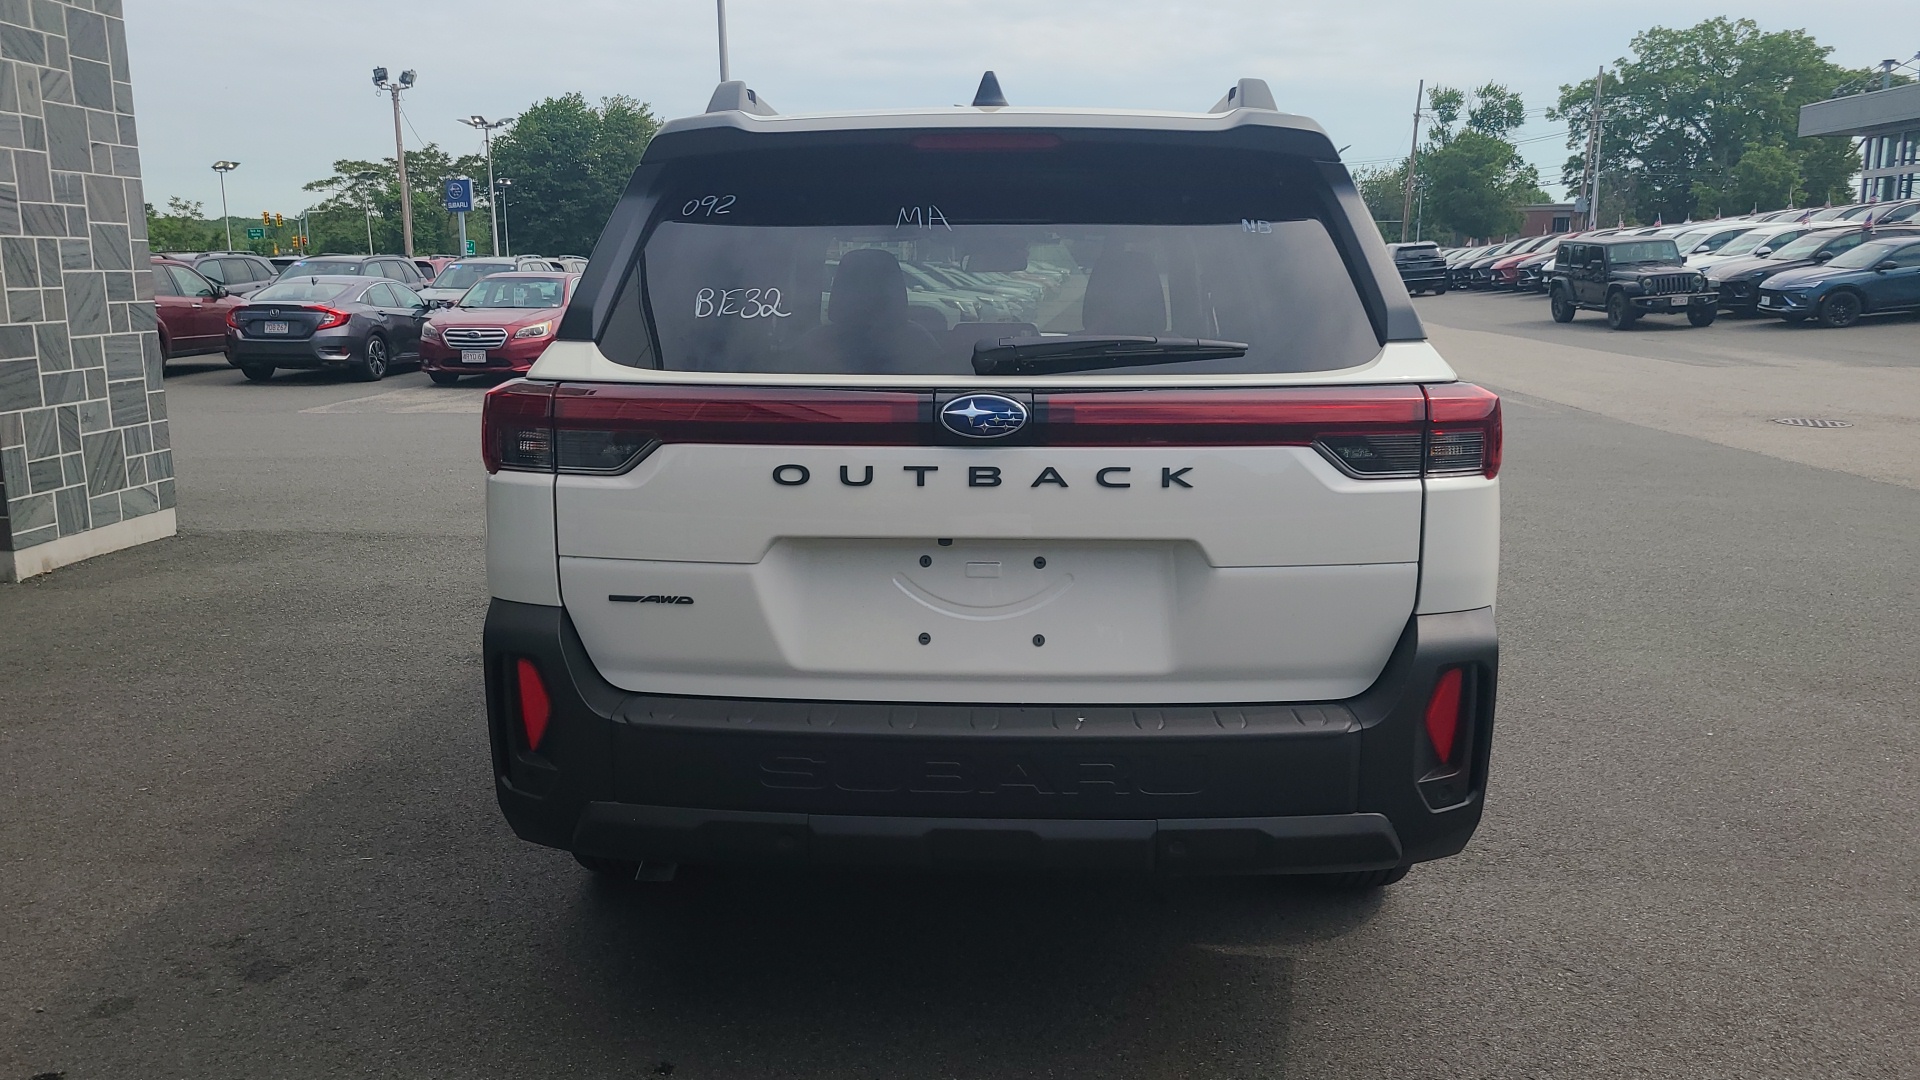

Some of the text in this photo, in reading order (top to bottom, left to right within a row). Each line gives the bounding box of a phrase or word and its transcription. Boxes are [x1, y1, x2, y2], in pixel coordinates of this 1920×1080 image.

[448, 201, 469, 209] SUBARU
[682, 194, 737, 217] 092
[896, 205, 952, 232] MA
[772, 464, 1194, 489] OUTBACK
[640, 595, 695, 605] AWD
[758, 749, 1206, 796] SUBARU
